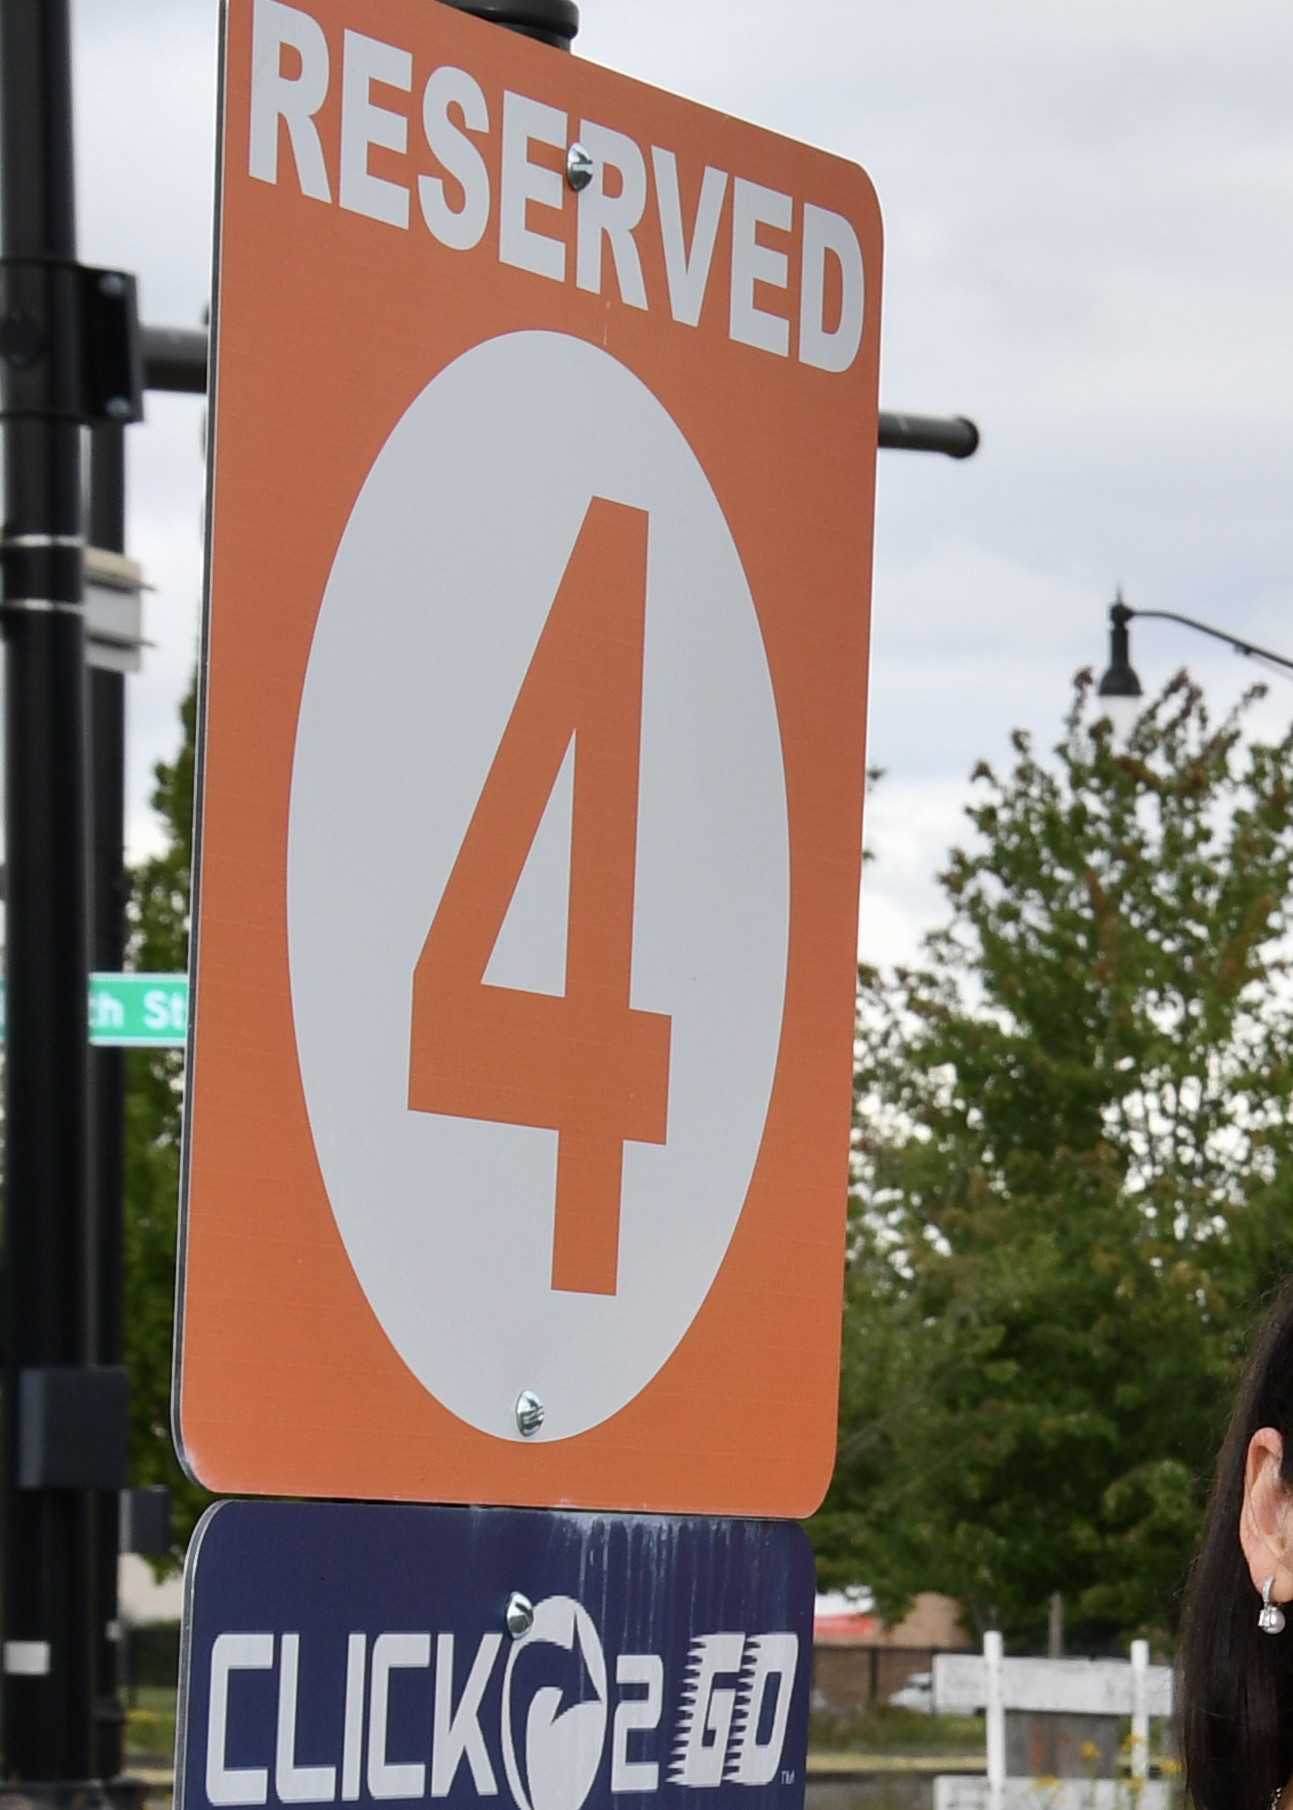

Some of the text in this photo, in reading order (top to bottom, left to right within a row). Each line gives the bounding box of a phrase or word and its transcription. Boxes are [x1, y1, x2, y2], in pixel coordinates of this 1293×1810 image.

[249, 0, 864, 374] RESERVED
[408, 496, 672, 1297] 4
[206, 1632, 503, 1807] CLICK
[611, 1655, 664, 1794] 2
[667, 1631, 799, 1788] GO
